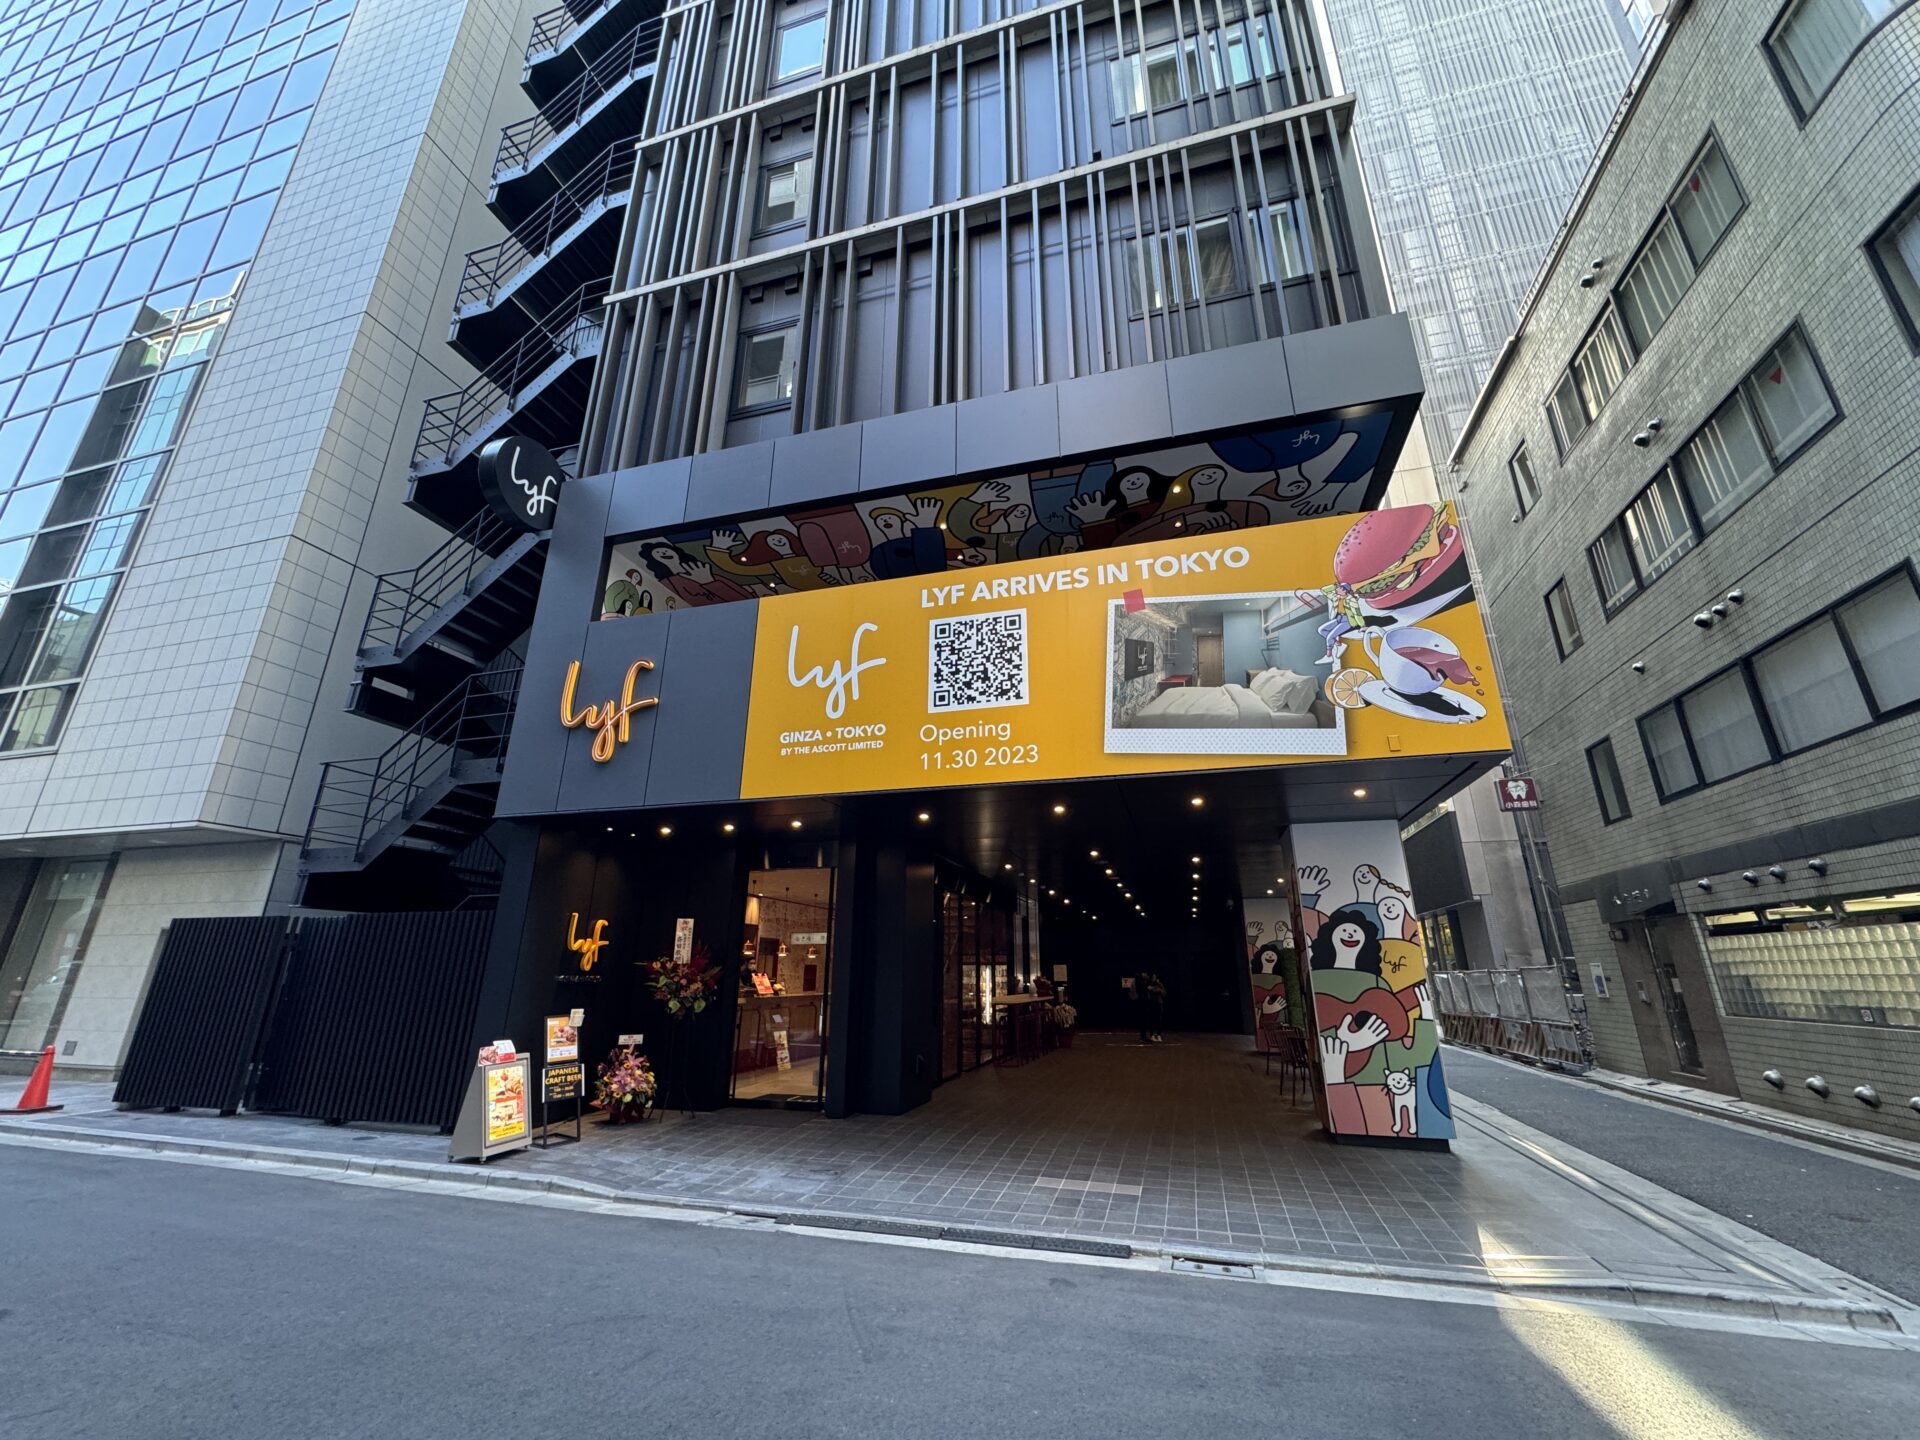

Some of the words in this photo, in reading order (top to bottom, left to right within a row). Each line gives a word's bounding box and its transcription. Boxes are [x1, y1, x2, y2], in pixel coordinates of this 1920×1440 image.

[510, 446, 558, 516] lyf
[921, 584, 965, 608] LYF
[971, 567, 1089, 601] ARRIVES
[1098, 562, 1128, 584] IN
[1135, 545, 1250, 579] TOKYO
[788, 622, 887, 719] lyf
[560, 658, 659, 763] lyf
[780, 730, 823, 744] GINZA
[836, 723, 886, 739] TOKYO
[920, 720, 1011, 745] Opening
[781, 747, 792, 756] BY
[794, 746, 810, 755] THE
[812, 743, 847, 753] ASCOTT
[848, 740, 884, 750] LIMITED
[920, 748, 978, 770] 11.30
[984, 744, 1039, 766] 2023
[567, 912, 609, 971] lyf
[545, 1076, 566, 1085] CRAFT
[548, 1067, 579, 1077] JAPANESE
